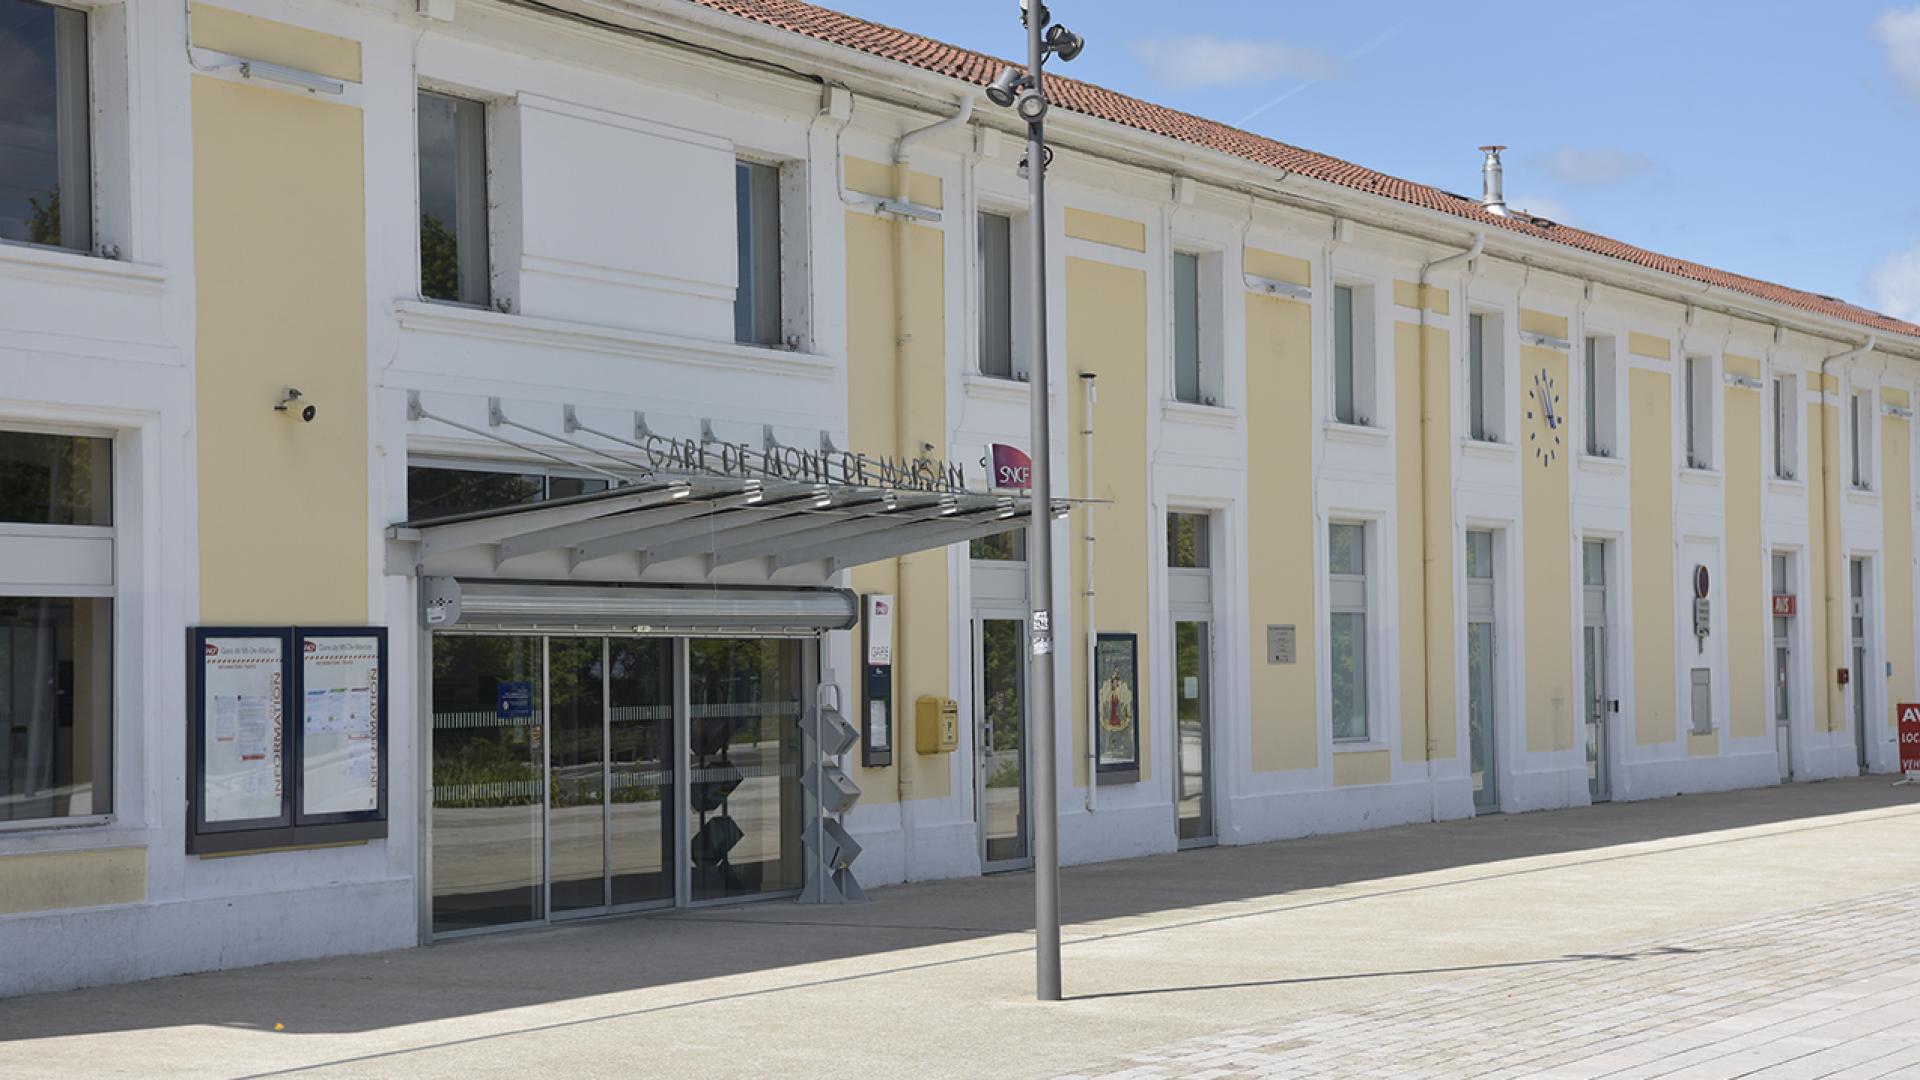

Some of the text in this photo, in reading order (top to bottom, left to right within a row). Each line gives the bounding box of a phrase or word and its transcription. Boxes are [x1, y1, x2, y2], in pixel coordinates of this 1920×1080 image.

[646, 436, 966, 492] GARE DE MONT DE MARSAN
[999, 464, 1030, 484] SNCF
[273, 672, 281, 797] INFORMATION
